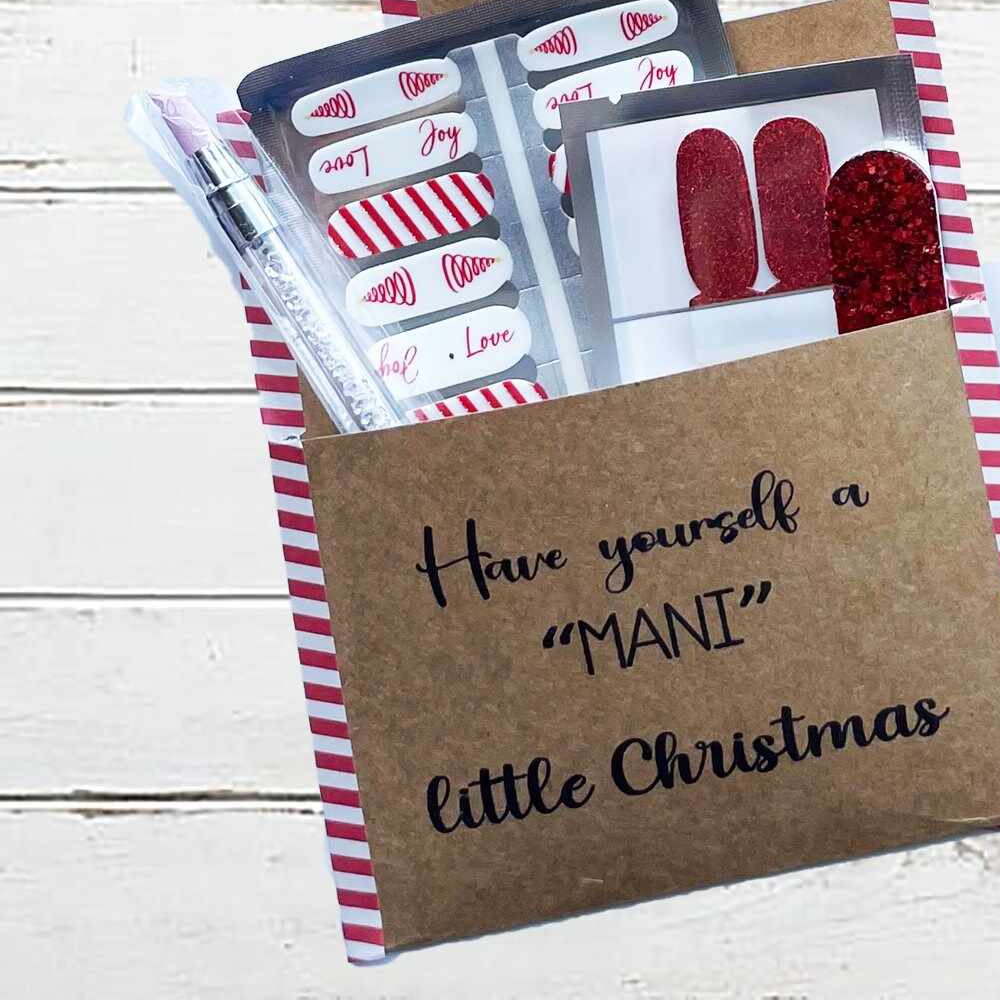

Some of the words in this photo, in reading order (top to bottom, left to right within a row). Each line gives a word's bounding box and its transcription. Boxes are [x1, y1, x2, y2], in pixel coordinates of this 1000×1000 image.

[638, 57, 678, 90] Joy
[419, 118, 461, 160] Joy
[319, 145, 369, 177] Love
[466, 326, 515, 358] Love
[416, 518, 568, 608] Have
[599, 470, 799, 594] yourself
[831, 483, 869, 508] a
[425, 757, 595, 834] little
[610, 698, 950, 796] Christmas
